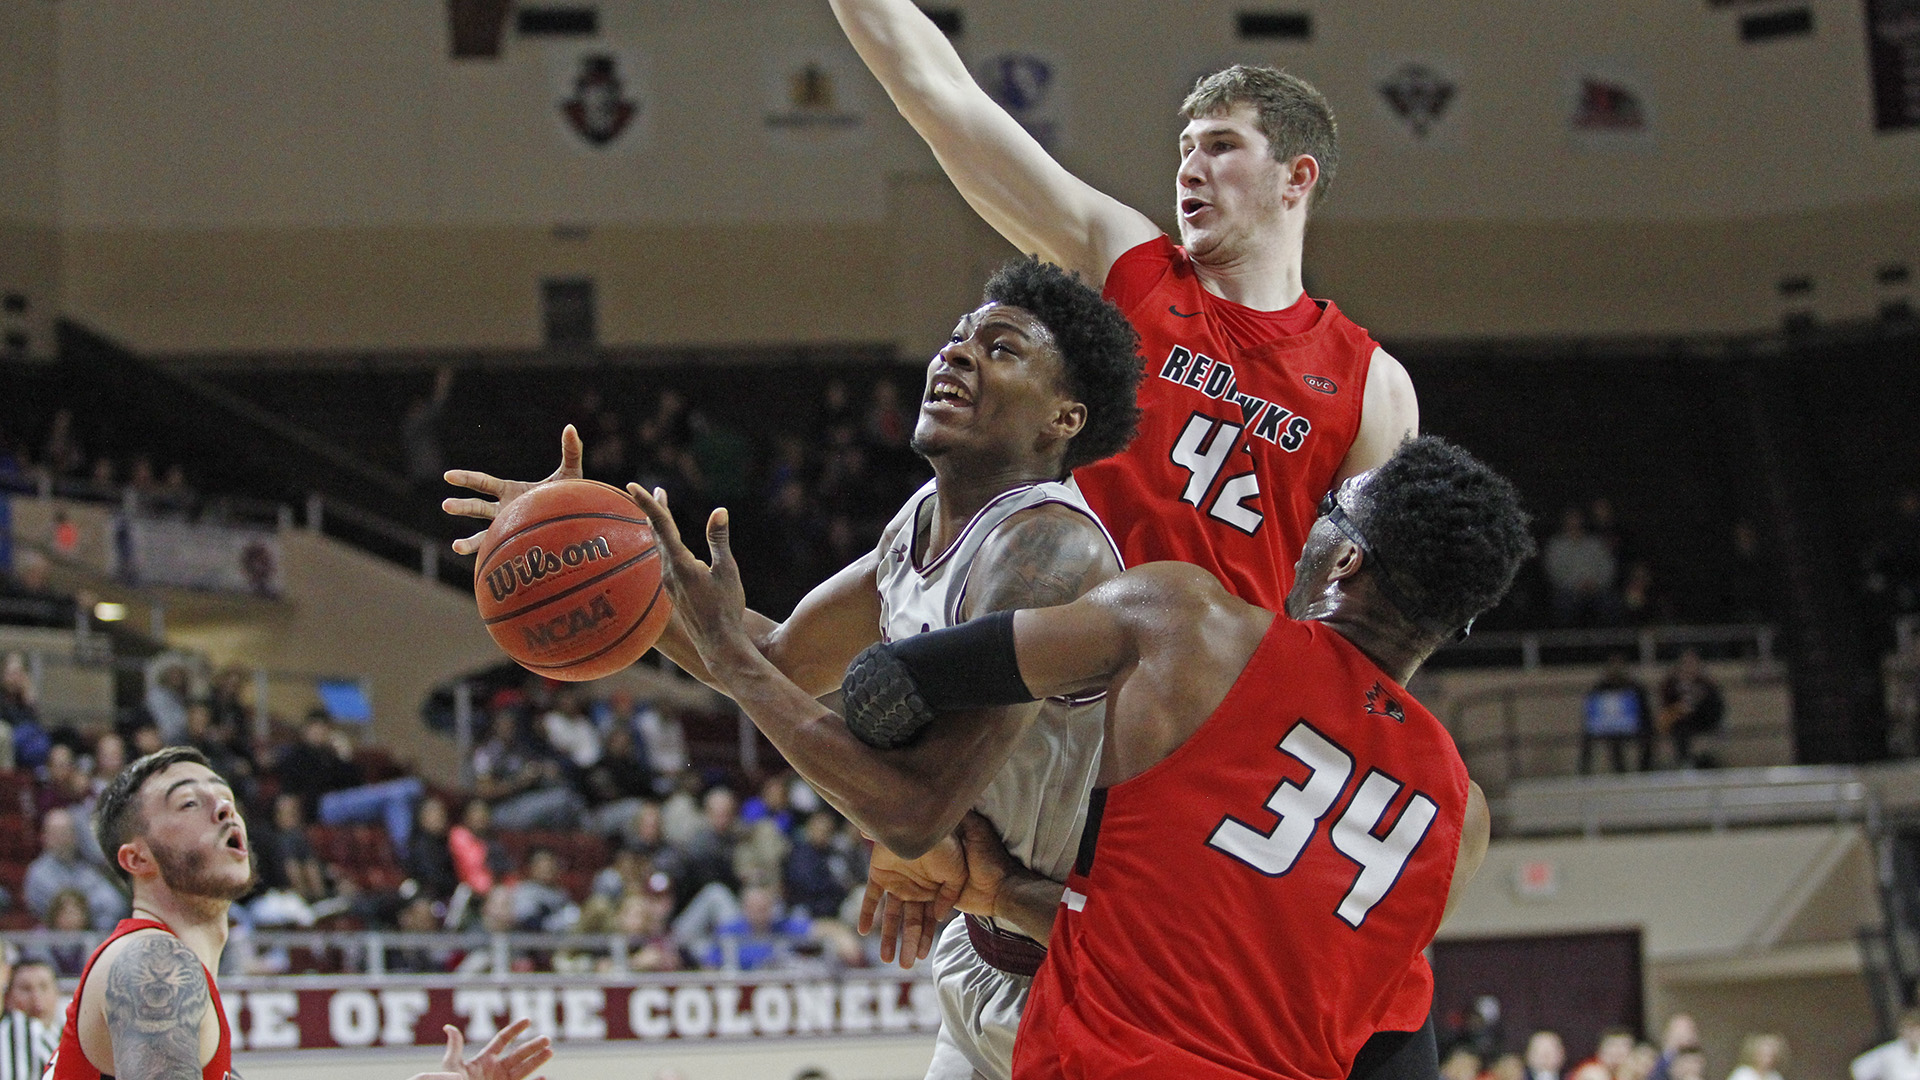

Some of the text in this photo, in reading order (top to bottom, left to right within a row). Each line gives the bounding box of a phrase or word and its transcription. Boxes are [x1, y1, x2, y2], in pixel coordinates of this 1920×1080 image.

[1159, 344, 1311, 453] REDWKS
[1308, 379, 1330, 390] OVC
[1168, 410, 1265, 538] 42
[485, 536, 613, 604] Wilson
[521, 593, 617, 651] NCAA
[1203, 717, 1441, 932] 34
[328, 990, 430, 1047] OF
[453, 987, 607, 1043] THE
[628, 983, 942, 1038] COLONELS
